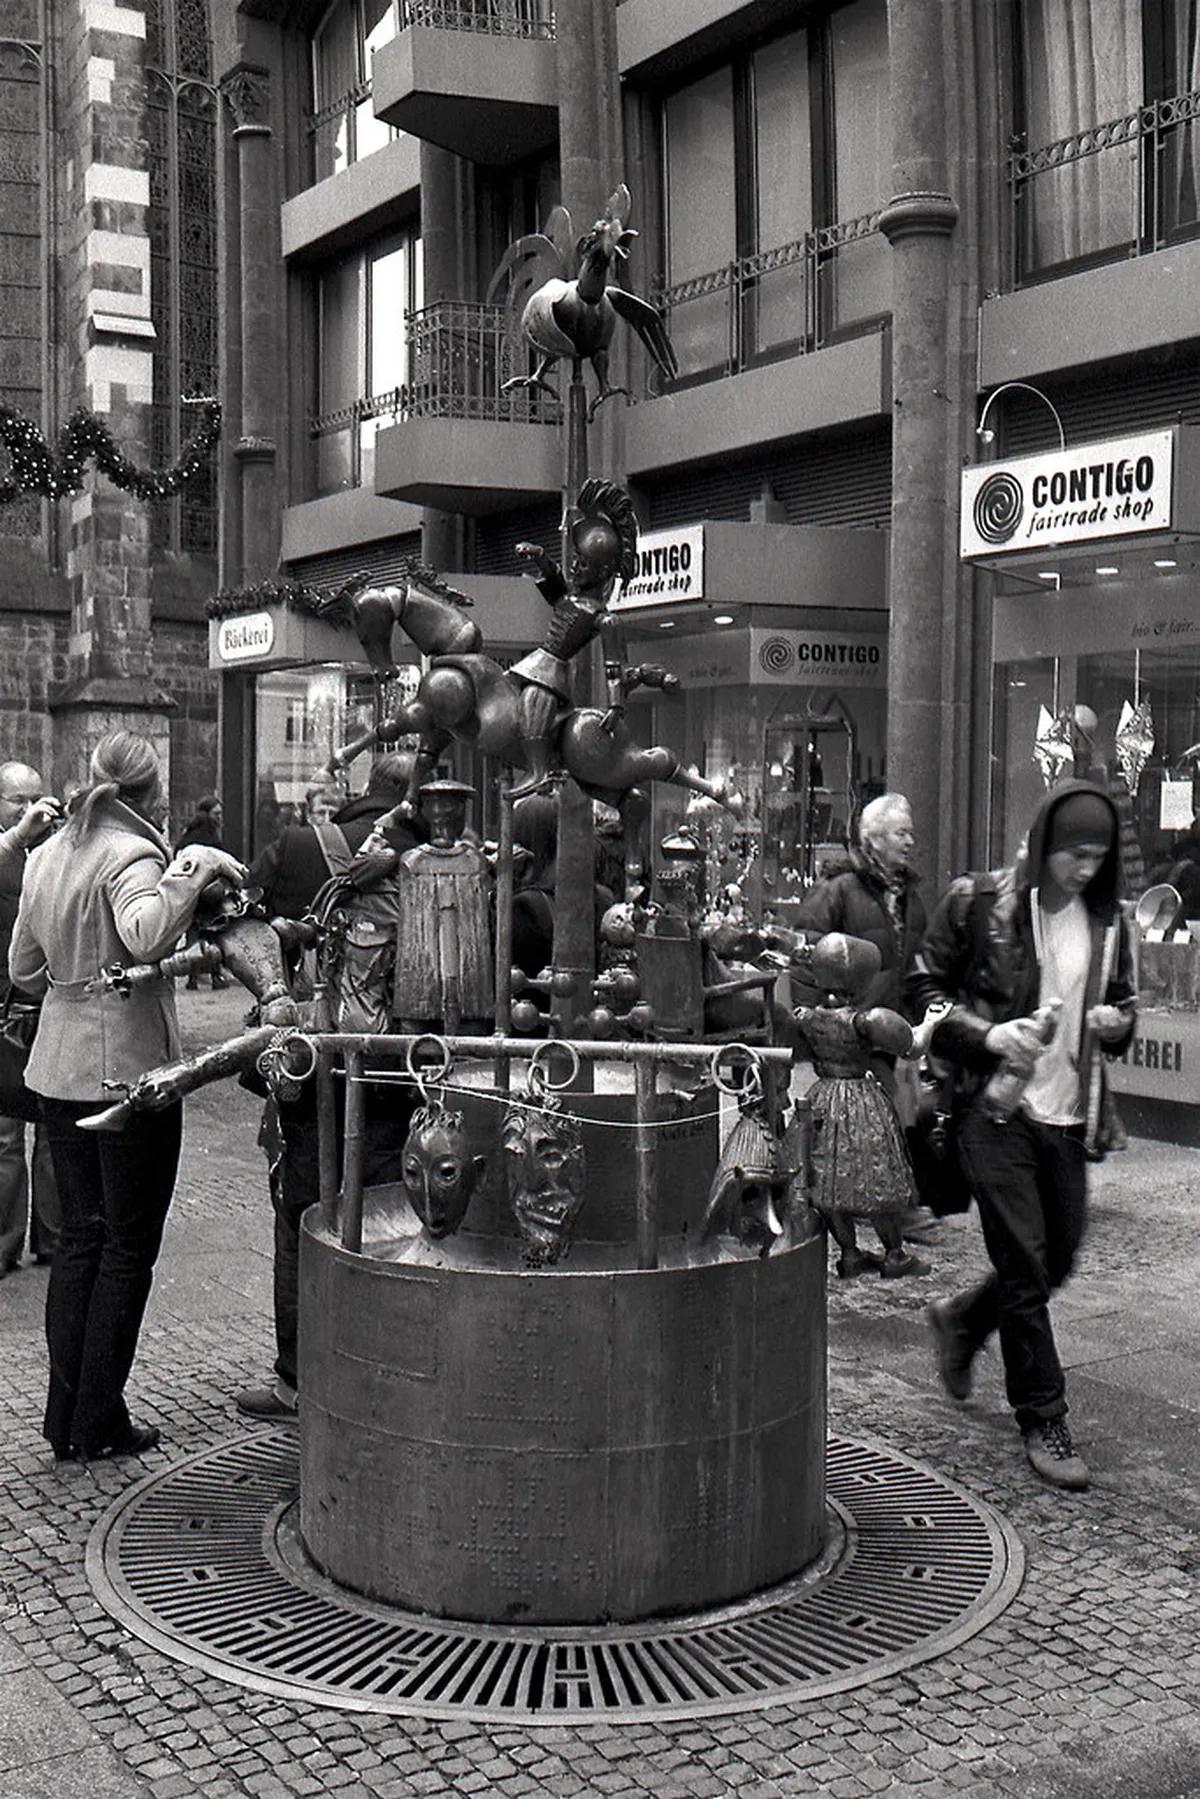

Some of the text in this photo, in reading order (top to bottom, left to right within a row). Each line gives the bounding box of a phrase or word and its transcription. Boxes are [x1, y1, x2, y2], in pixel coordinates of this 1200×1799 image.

[1032, 455, 1153, 508] CONTIGO
[1025, 496, 1154, 538] fairtrade shop
[632, 543, 691, 578] ONTIGO
[667, 573, 692, 593] shop
[799, 643, 880, 663] CONTIGO
